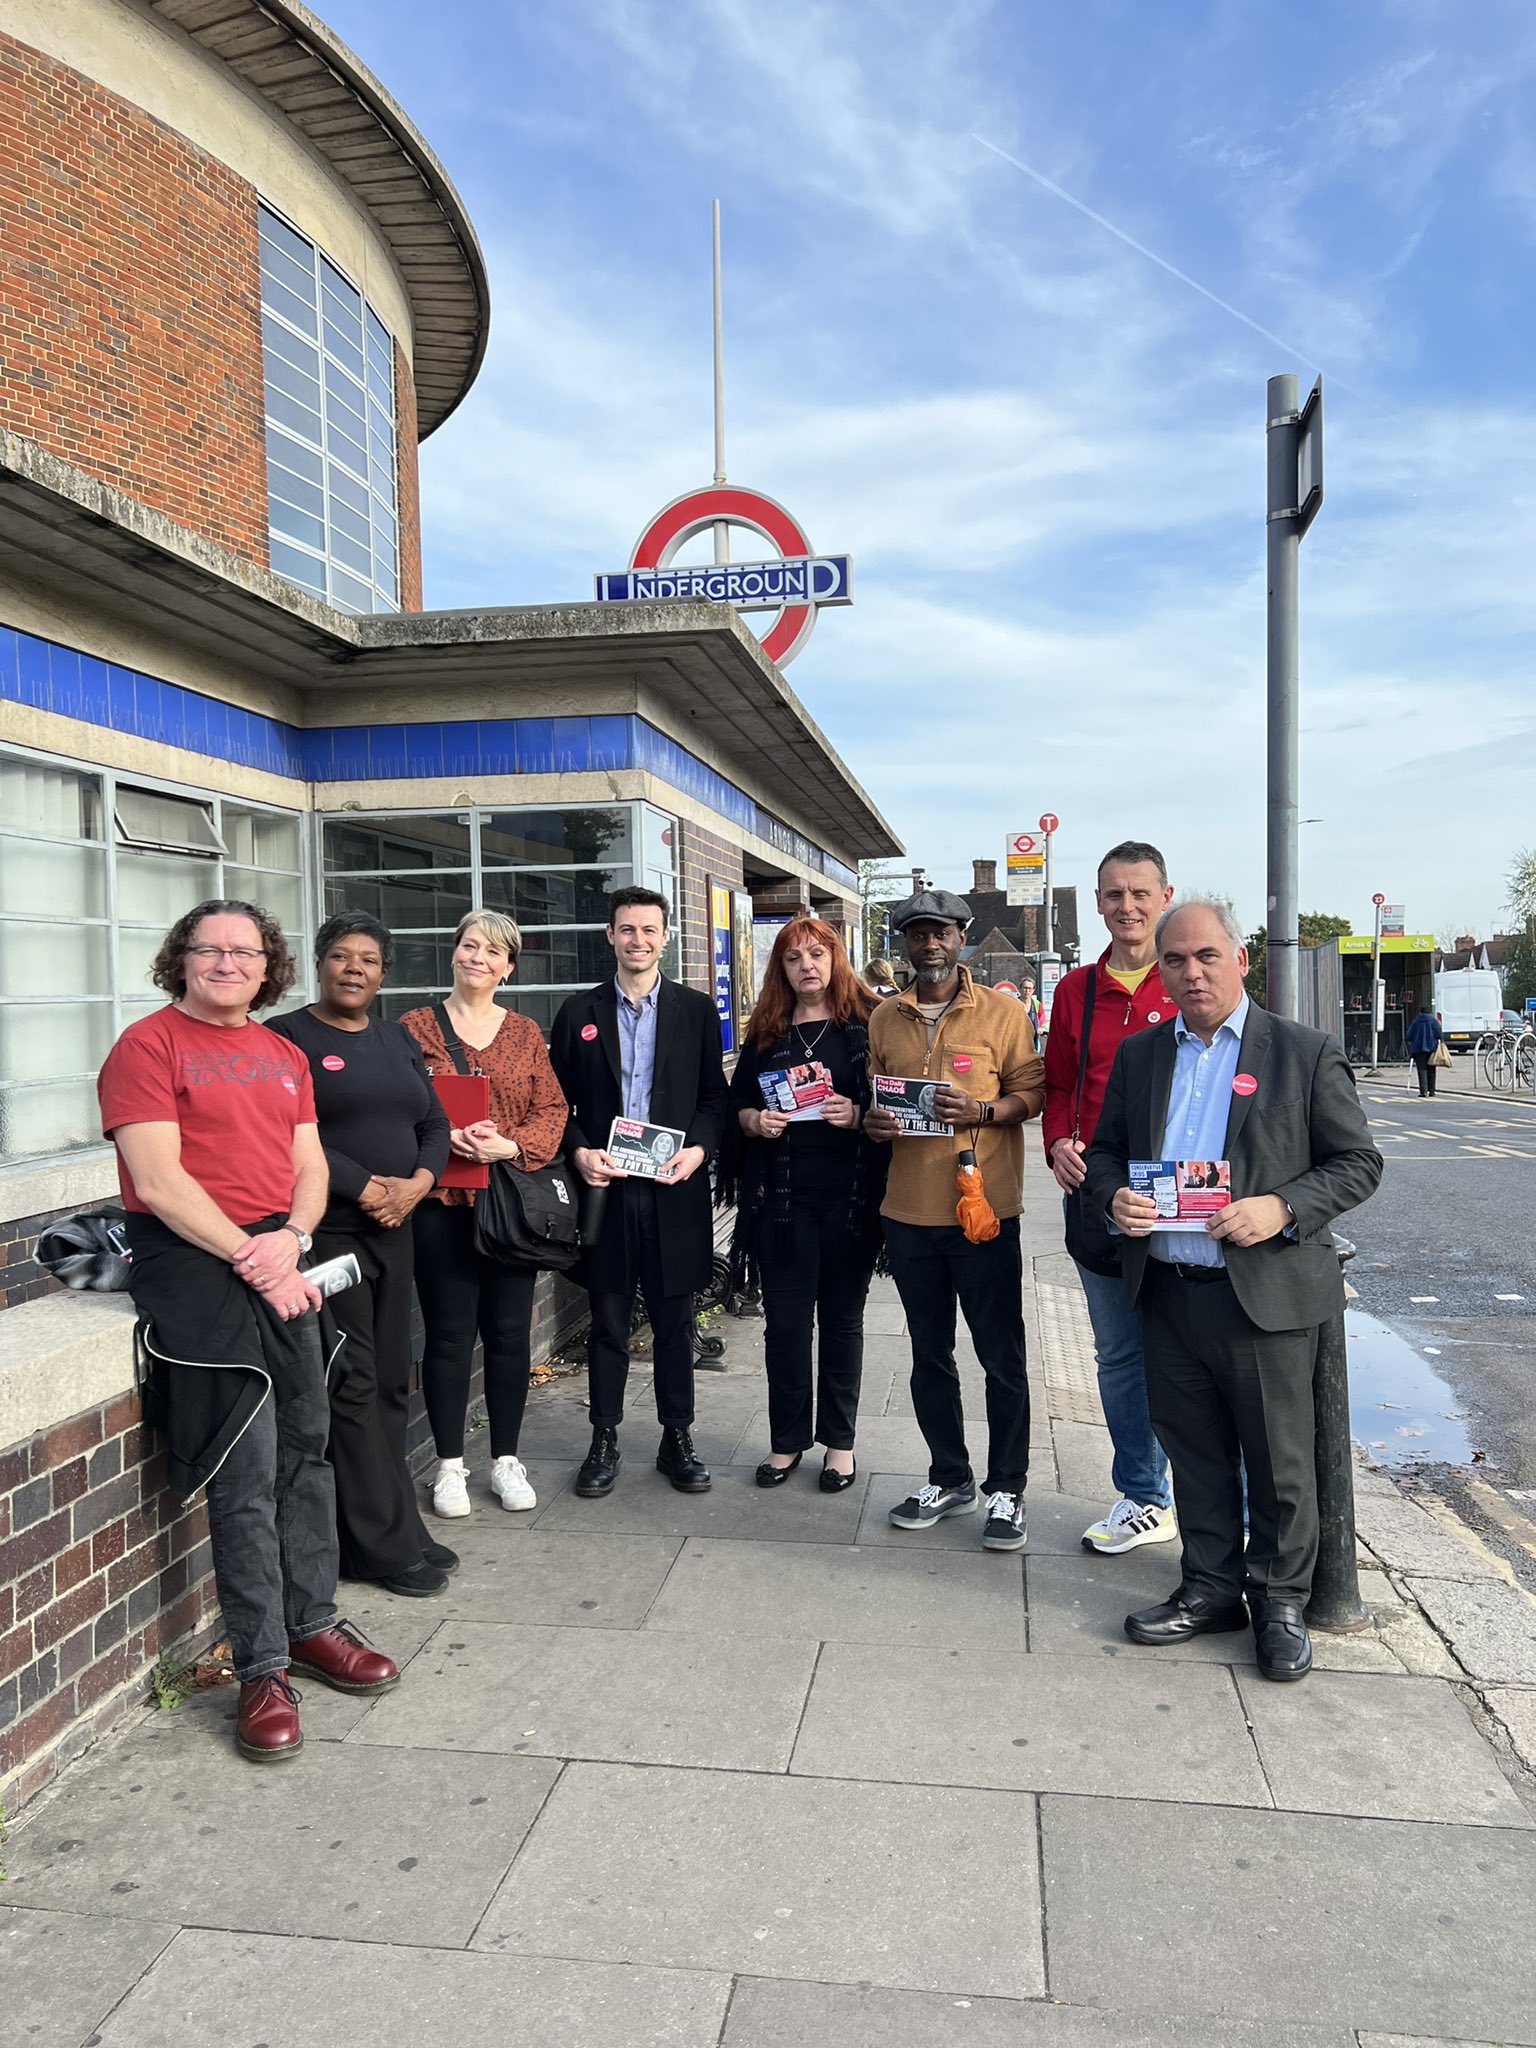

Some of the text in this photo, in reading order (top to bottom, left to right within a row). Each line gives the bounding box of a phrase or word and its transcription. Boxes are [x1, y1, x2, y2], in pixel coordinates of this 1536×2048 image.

[602, 559, 841, 602] UNDERGROUND
[1042, 816, 1055, 831] T
[877, 1084, 905, 1094] CHAOS
[912, 1120, 927, 1131] THE
[929, 1121, 947, 1133] BILL
[625, 1159, 641, 1171] PAY
[641, 1163, 656, 1174] THE
